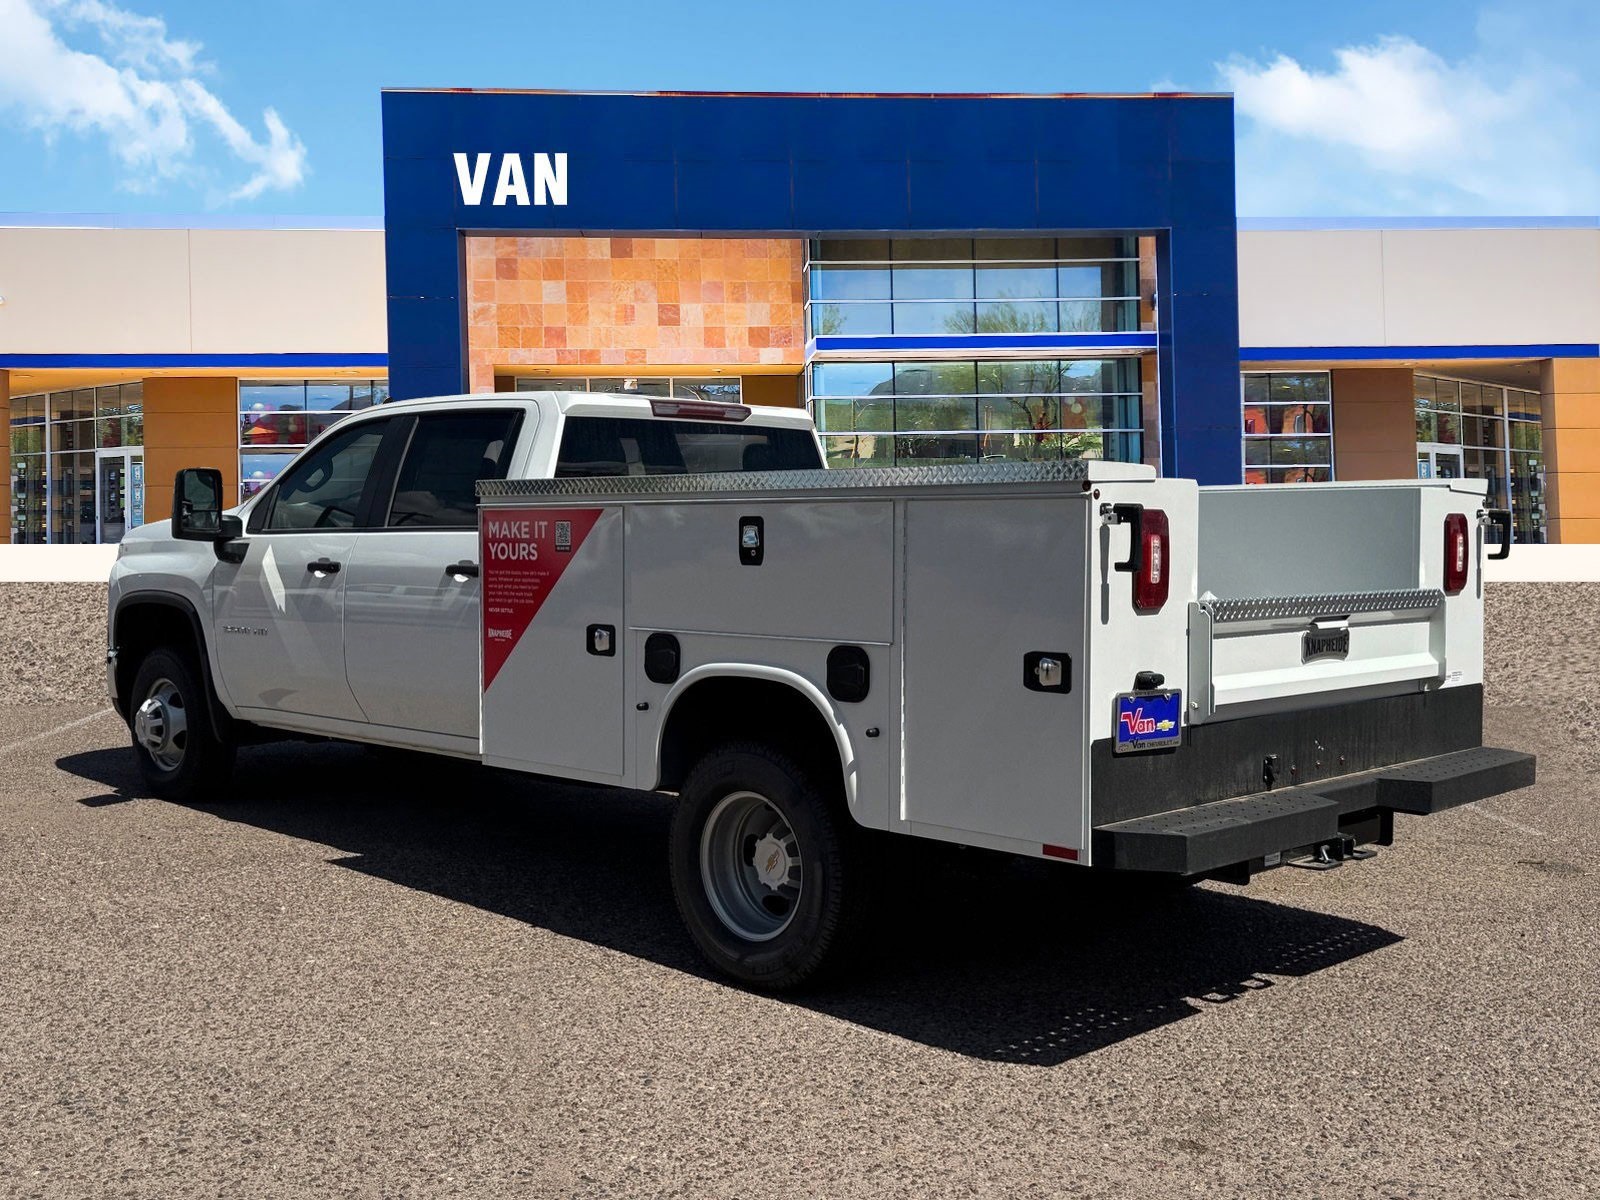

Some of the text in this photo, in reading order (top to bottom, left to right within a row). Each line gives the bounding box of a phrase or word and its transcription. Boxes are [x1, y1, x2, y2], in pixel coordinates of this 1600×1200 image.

[453, 152, 568, 206] VAN
[488, 521, 548, 539] MAKE IT
[488, 542, 538, 560] YOURS
[1305, 633, 1348, 658] KNAPHEIDE
[1121, 708, 1156, 735] Van
[1129, 738, 1146, 749] Van
